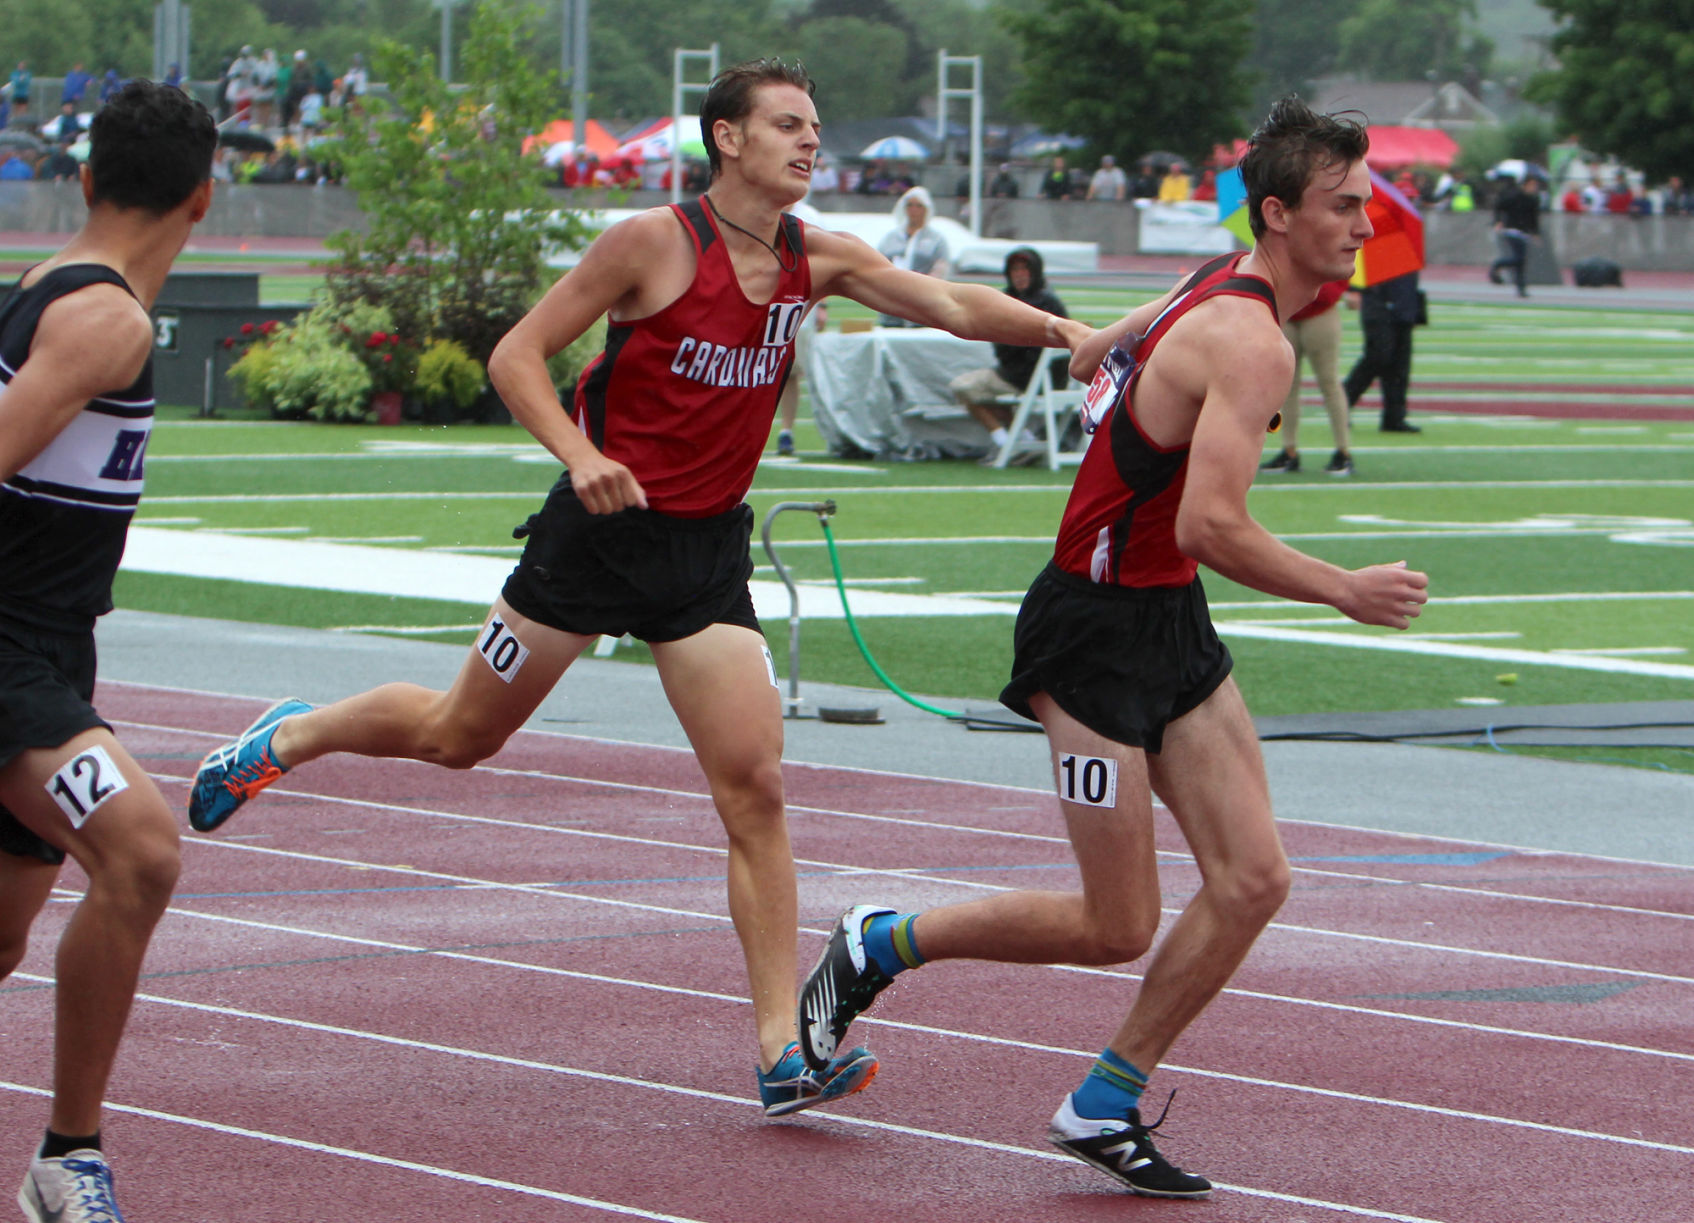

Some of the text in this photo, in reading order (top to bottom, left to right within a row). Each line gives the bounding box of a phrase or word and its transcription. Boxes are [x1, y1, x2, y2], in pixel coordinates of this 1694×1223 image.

[767, 304, 803, 344] 10
[482, 621, 519, 673] 10
[54, 754, 116, 817] 12
[1062, 755, 1108, 804] 10
